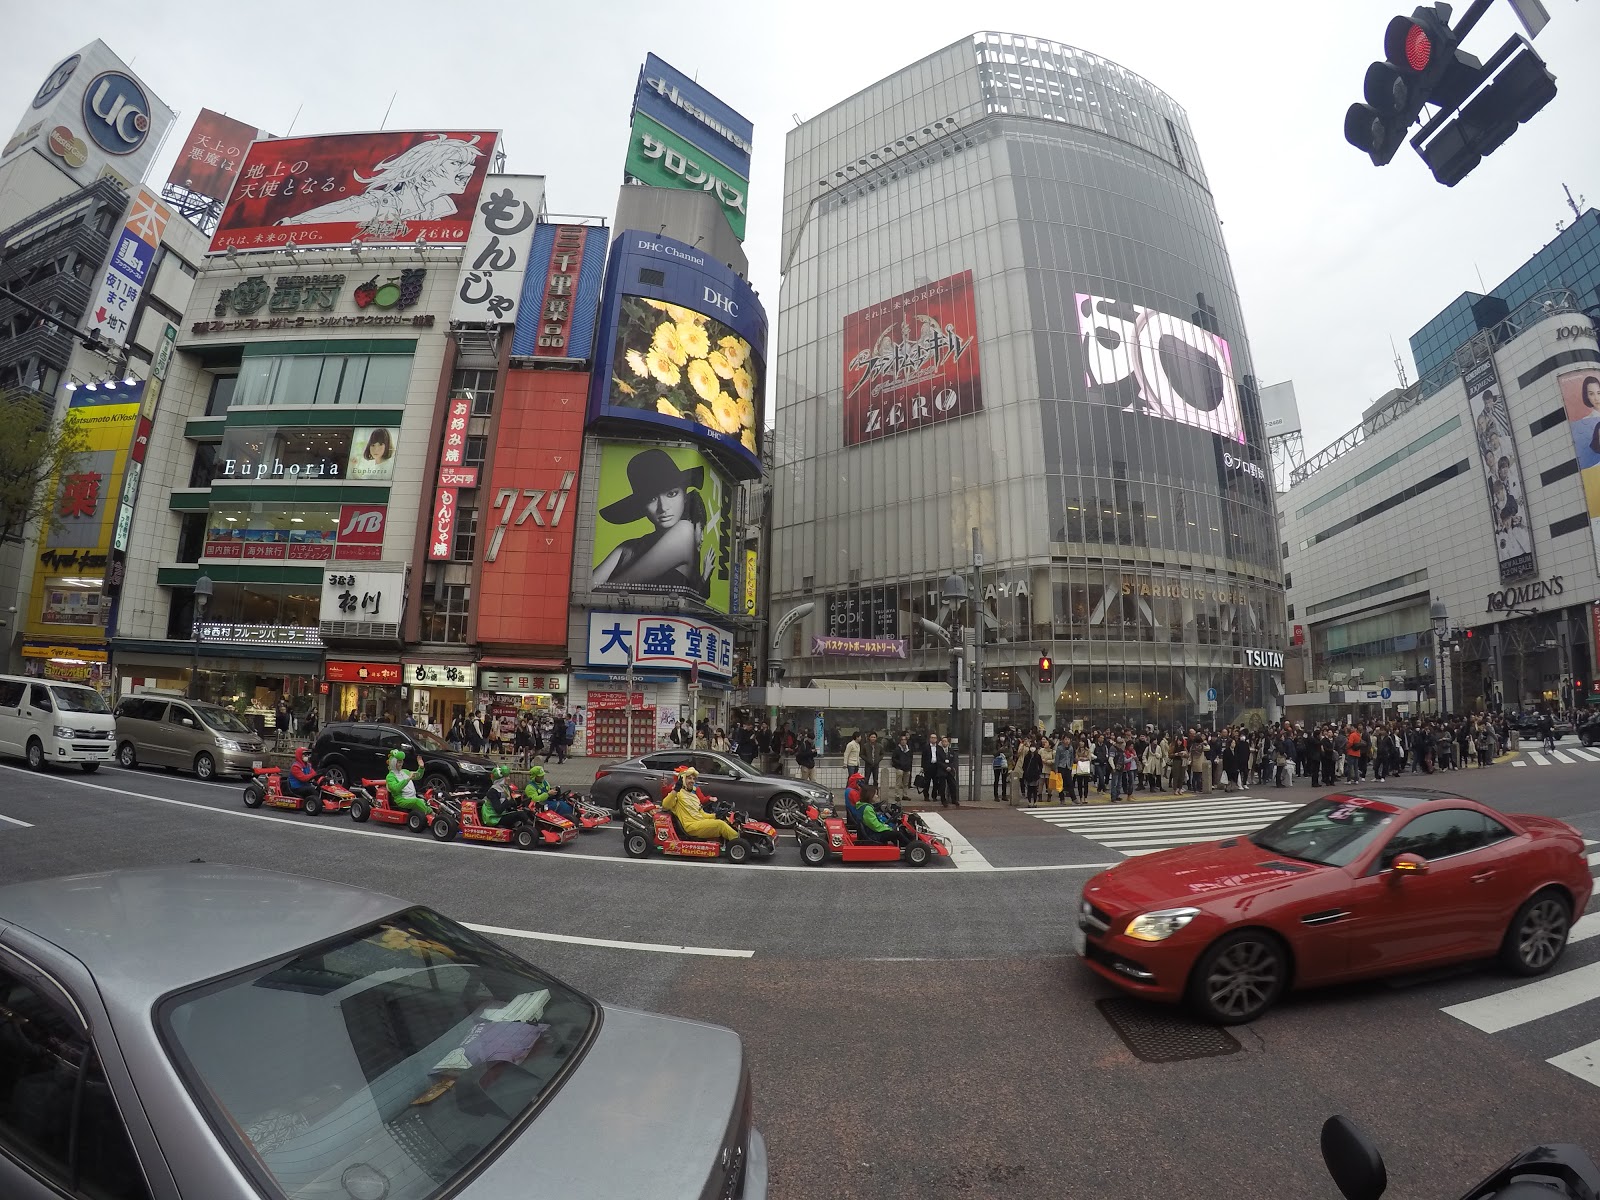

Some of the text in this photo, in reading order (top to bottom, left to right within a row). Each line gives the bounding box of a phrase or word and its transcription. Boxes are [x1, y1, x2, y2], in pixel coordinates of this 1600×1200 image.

[51, 130, 87, 162] MasterCard
[197, 133, 240, 157] 天上の
[187, 146, 240, 175] 悪魔は、
[245, 160, 308, 179] 地上の
[641, 132, 745, 215] サロンパス
[236, 177, 346, 201] 天使となる。
[217, 230, 325, 246] それは、未来のRPG。
[417, 228, 464, 239] ZERO
[455, 188, 534, 319] もんじゃ
[638, 240, 705, 267] DHC Channel
[114, 257, 143, 280] ブックファースト
[105, 271, 139, 303] 夜11時
[107, 290, 129, 312] まで
[269, 285, 341, 314] 西村
[703, 286, 739, 318] DHC
[865, 284, 949, 321] それは、未来のRPG。
[106, 313, 128, 335] 地下
[69, 415, 110, 425] Matsumoto
[865, 387, 957, 433] ZERO
[445, 402, 467, 462] お好み焼
[707, 429, 722, 441] DHC
[222, 458, 340, 479] Euphoria
[60, 471, 103, 518] 薬
[341, 510, 383, 535] JTB
[433, 490, 453, 556] もんじゃ焼
[485, 471, 577, 562] クスリ
[206, 545, 240, 556] 国内旅行
[247, 546, 283, 557] 海外旅行
[290, 552, 331, 560] ウエディング
[928, 580, 1029, 606] TAYA
[1121, 583, 1205, 600] STARBUCKS
[830, 612, 864, 624] BOOK
[234, 627, 305, 640] フルーツパーラー
[600, 622, 731, 668] 大盛堂書店
[825, 640, 897, 653] バスケットボールストリート
[487, 674, 561, 690] 三千里薬品
[681, 849, 716, 857] MariCar.jp
